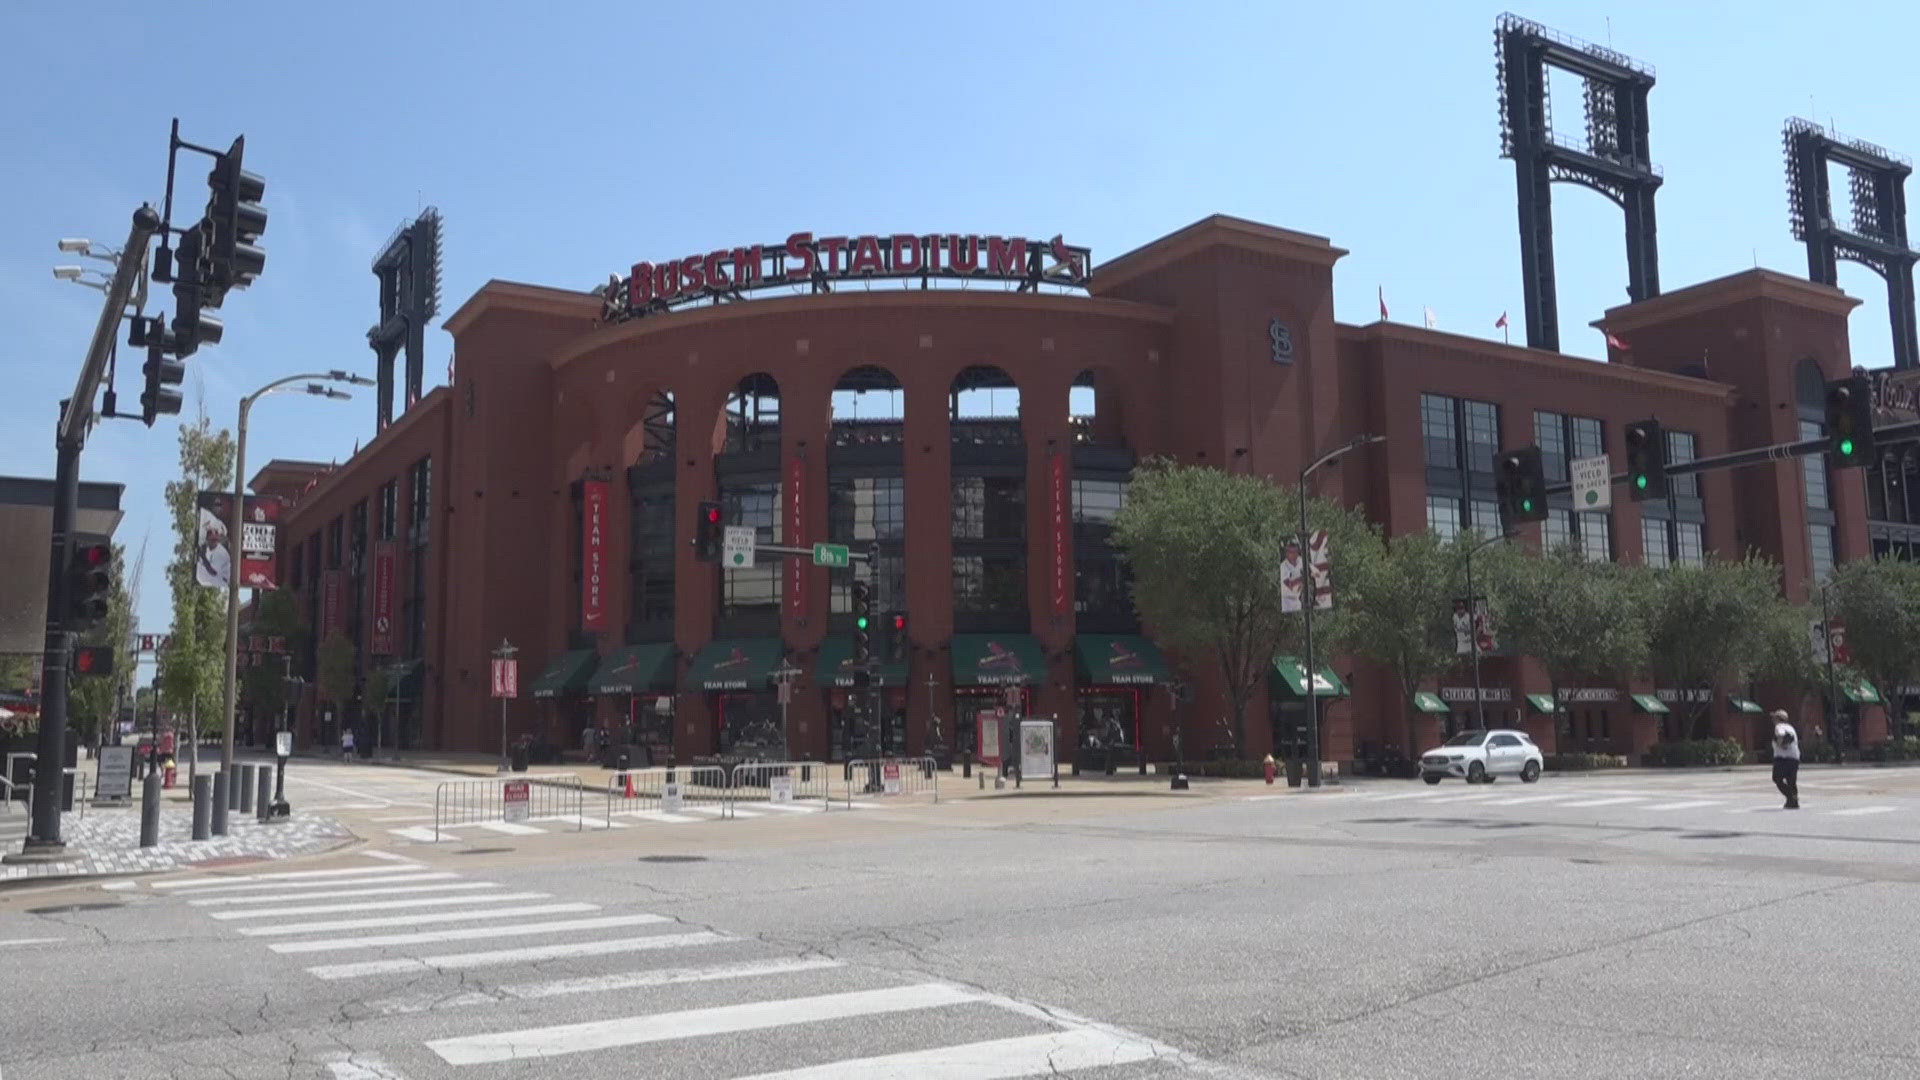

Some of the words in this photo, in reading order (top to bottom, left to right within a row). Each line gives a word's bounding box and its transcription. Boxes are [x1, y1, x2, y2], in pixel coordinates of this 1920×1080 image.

[630, 245, 764, 304] BUSCH
[786, 231, 1027, 281] STADIUM
[1574, 462, 1588, 471] LEFT
[1580, 468, 1601, 479] YIELD
[592, 503, 600, 546] TEAM
[820, 546, 834, 564] 8th
[591, 552, 600, 607] STORE
[704, 681, 722, 689] TEAM
[724, 680, 747, 689] STORE
[1112, 675, 1131, 684] TEAM
[1132, 675, 1154, 684] STORE
